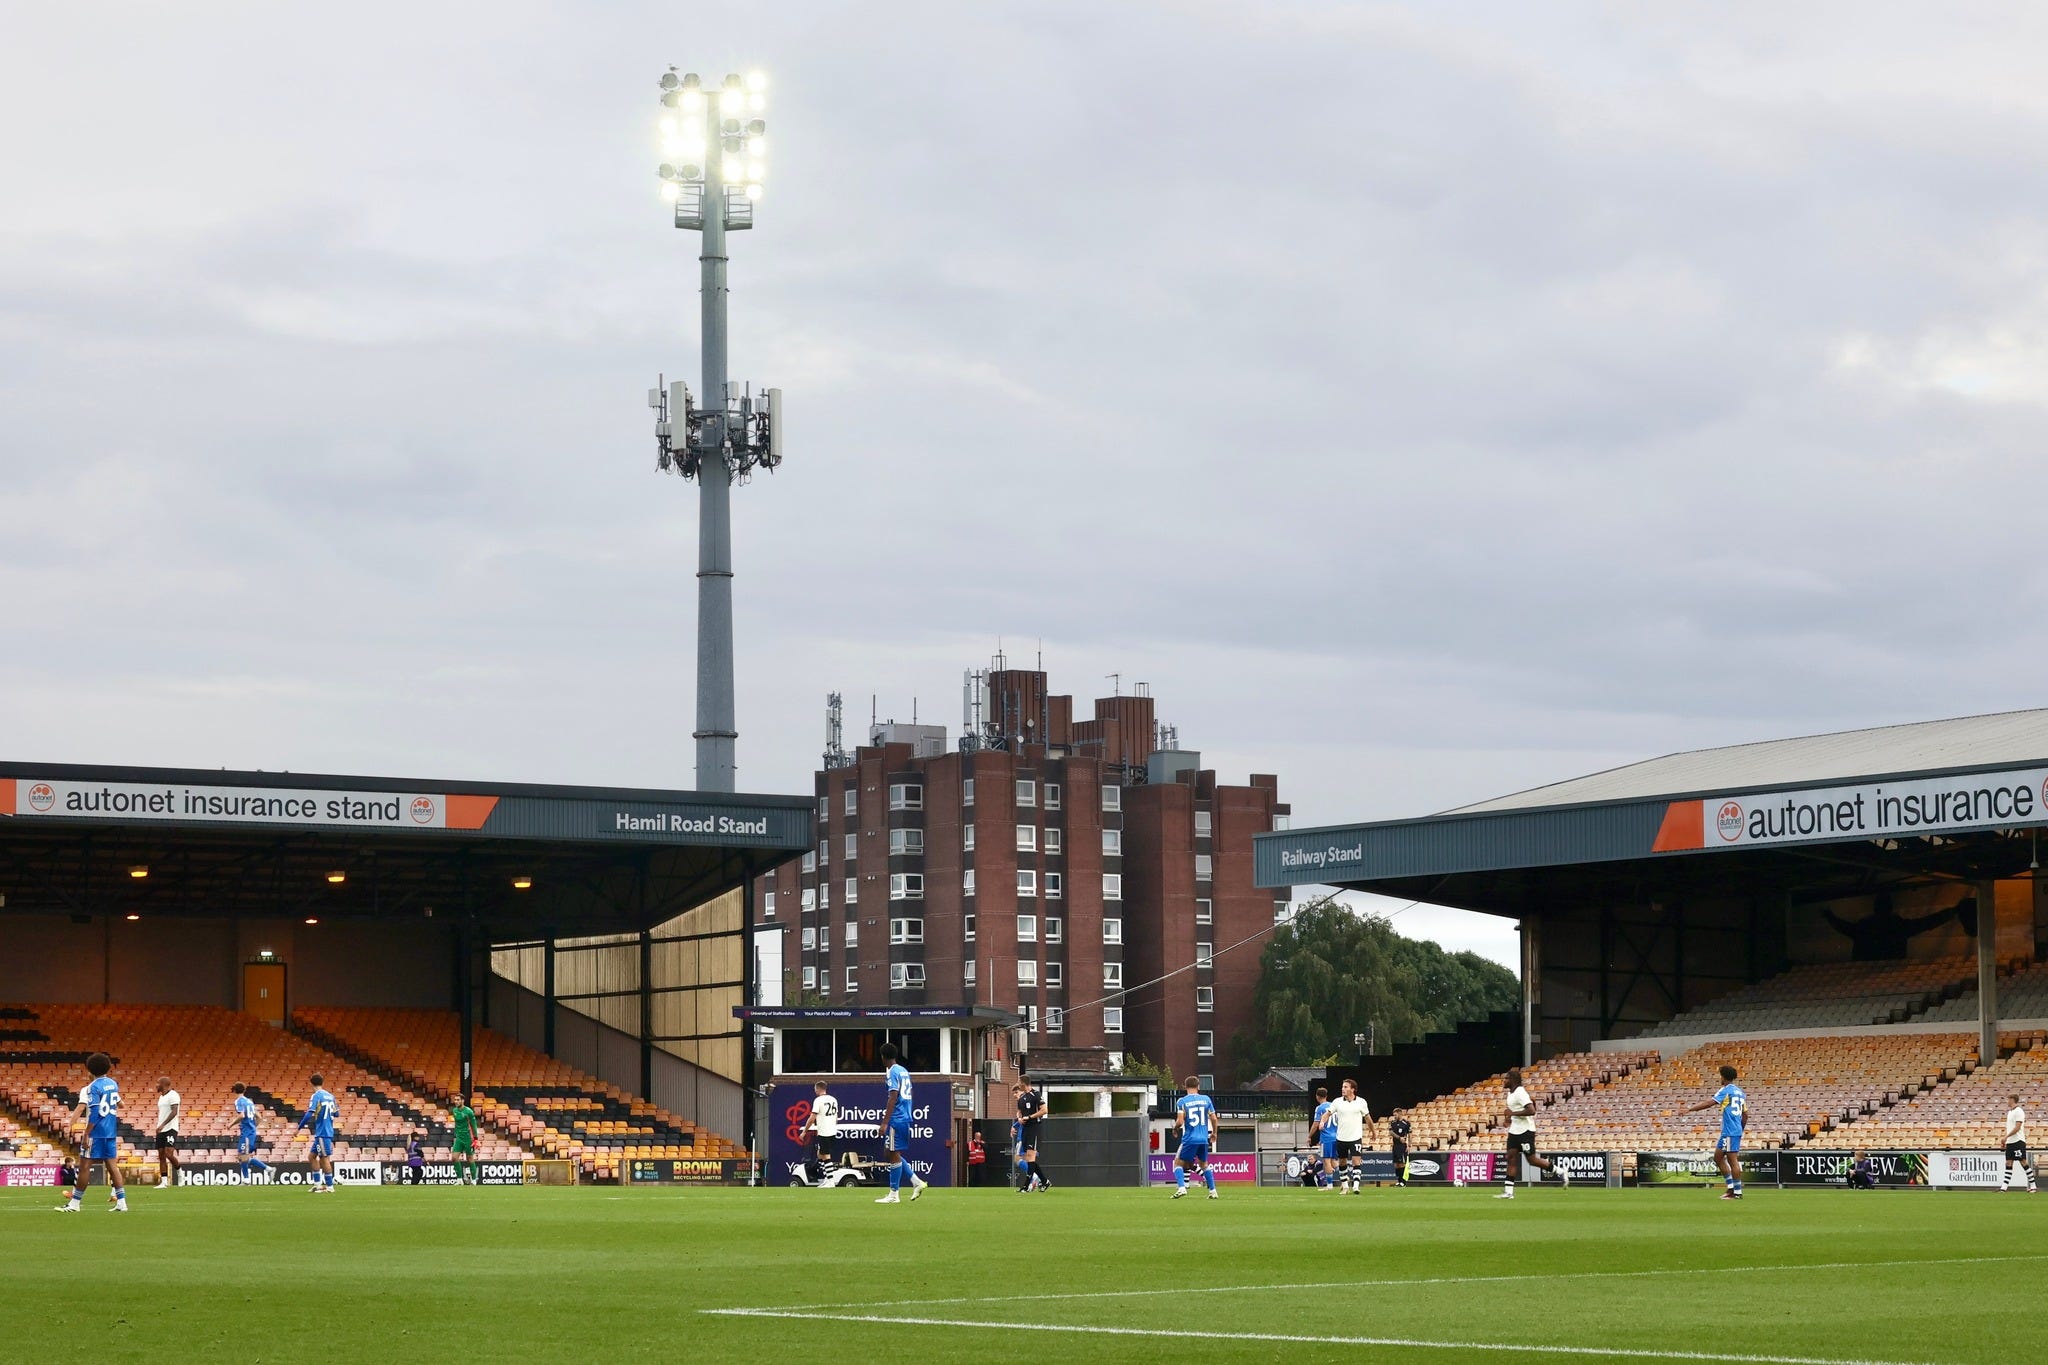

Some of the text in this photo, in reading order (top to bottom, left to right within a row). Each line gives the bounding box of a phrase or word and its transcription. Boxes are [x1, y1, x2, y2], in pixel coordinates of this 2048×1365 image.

[66, 788, 400, 821] autonet insurance stand
[1748, 785, 2034, 839] autonet insurance
[616, 813, 767, 834] Hamil Road Stand
[1282, 844, 1362, 868] Railway Stand
[824, 1102, 837, 1116] 26
[838, 1105, 930, 1120] Univers of
[1189, 1106, 1205, 1127] 51
[673, 1161, 722, 1174] BROWN
[1557, 1156, 1604, 1170] FOODHUB
[1689, 1161, 1717, 1172] DAYS
[1795, 1156, 1897, 1176] FRESHEW
[1960, 1157, 1997, 1171] Hilton
[7, 1167, 56, 1175] JOIN NOW
[340, 1168, 376, 1180] BLINK
[1454, 1166, 1487, 1179] FREE
[1949, 1172, 1997, 1181] Garden Inn
